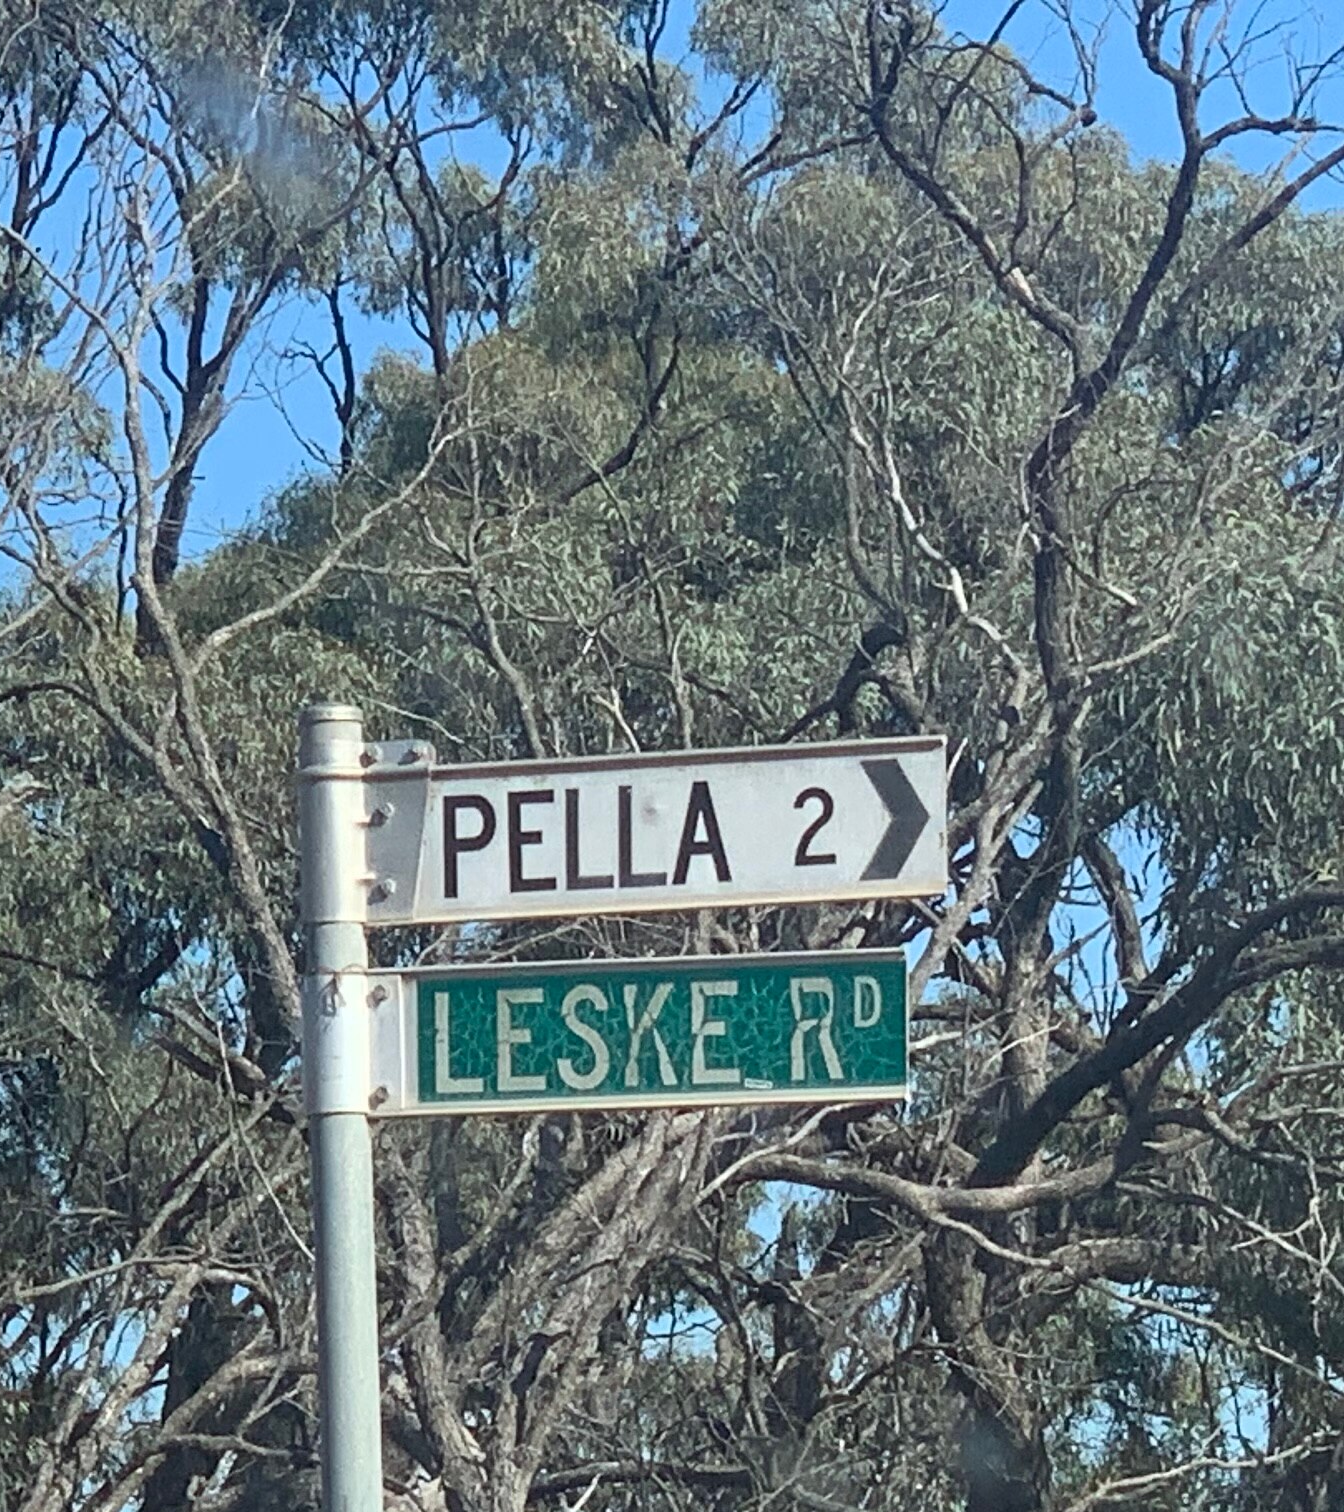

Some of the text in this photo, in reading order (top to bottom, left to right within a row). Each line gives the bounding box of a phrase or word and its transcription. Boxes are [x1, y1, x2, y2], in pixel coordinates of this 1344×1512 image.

[442, 780, 838, 899] PELLA 2
[434, 975, 884, 1095] LESKE RD
